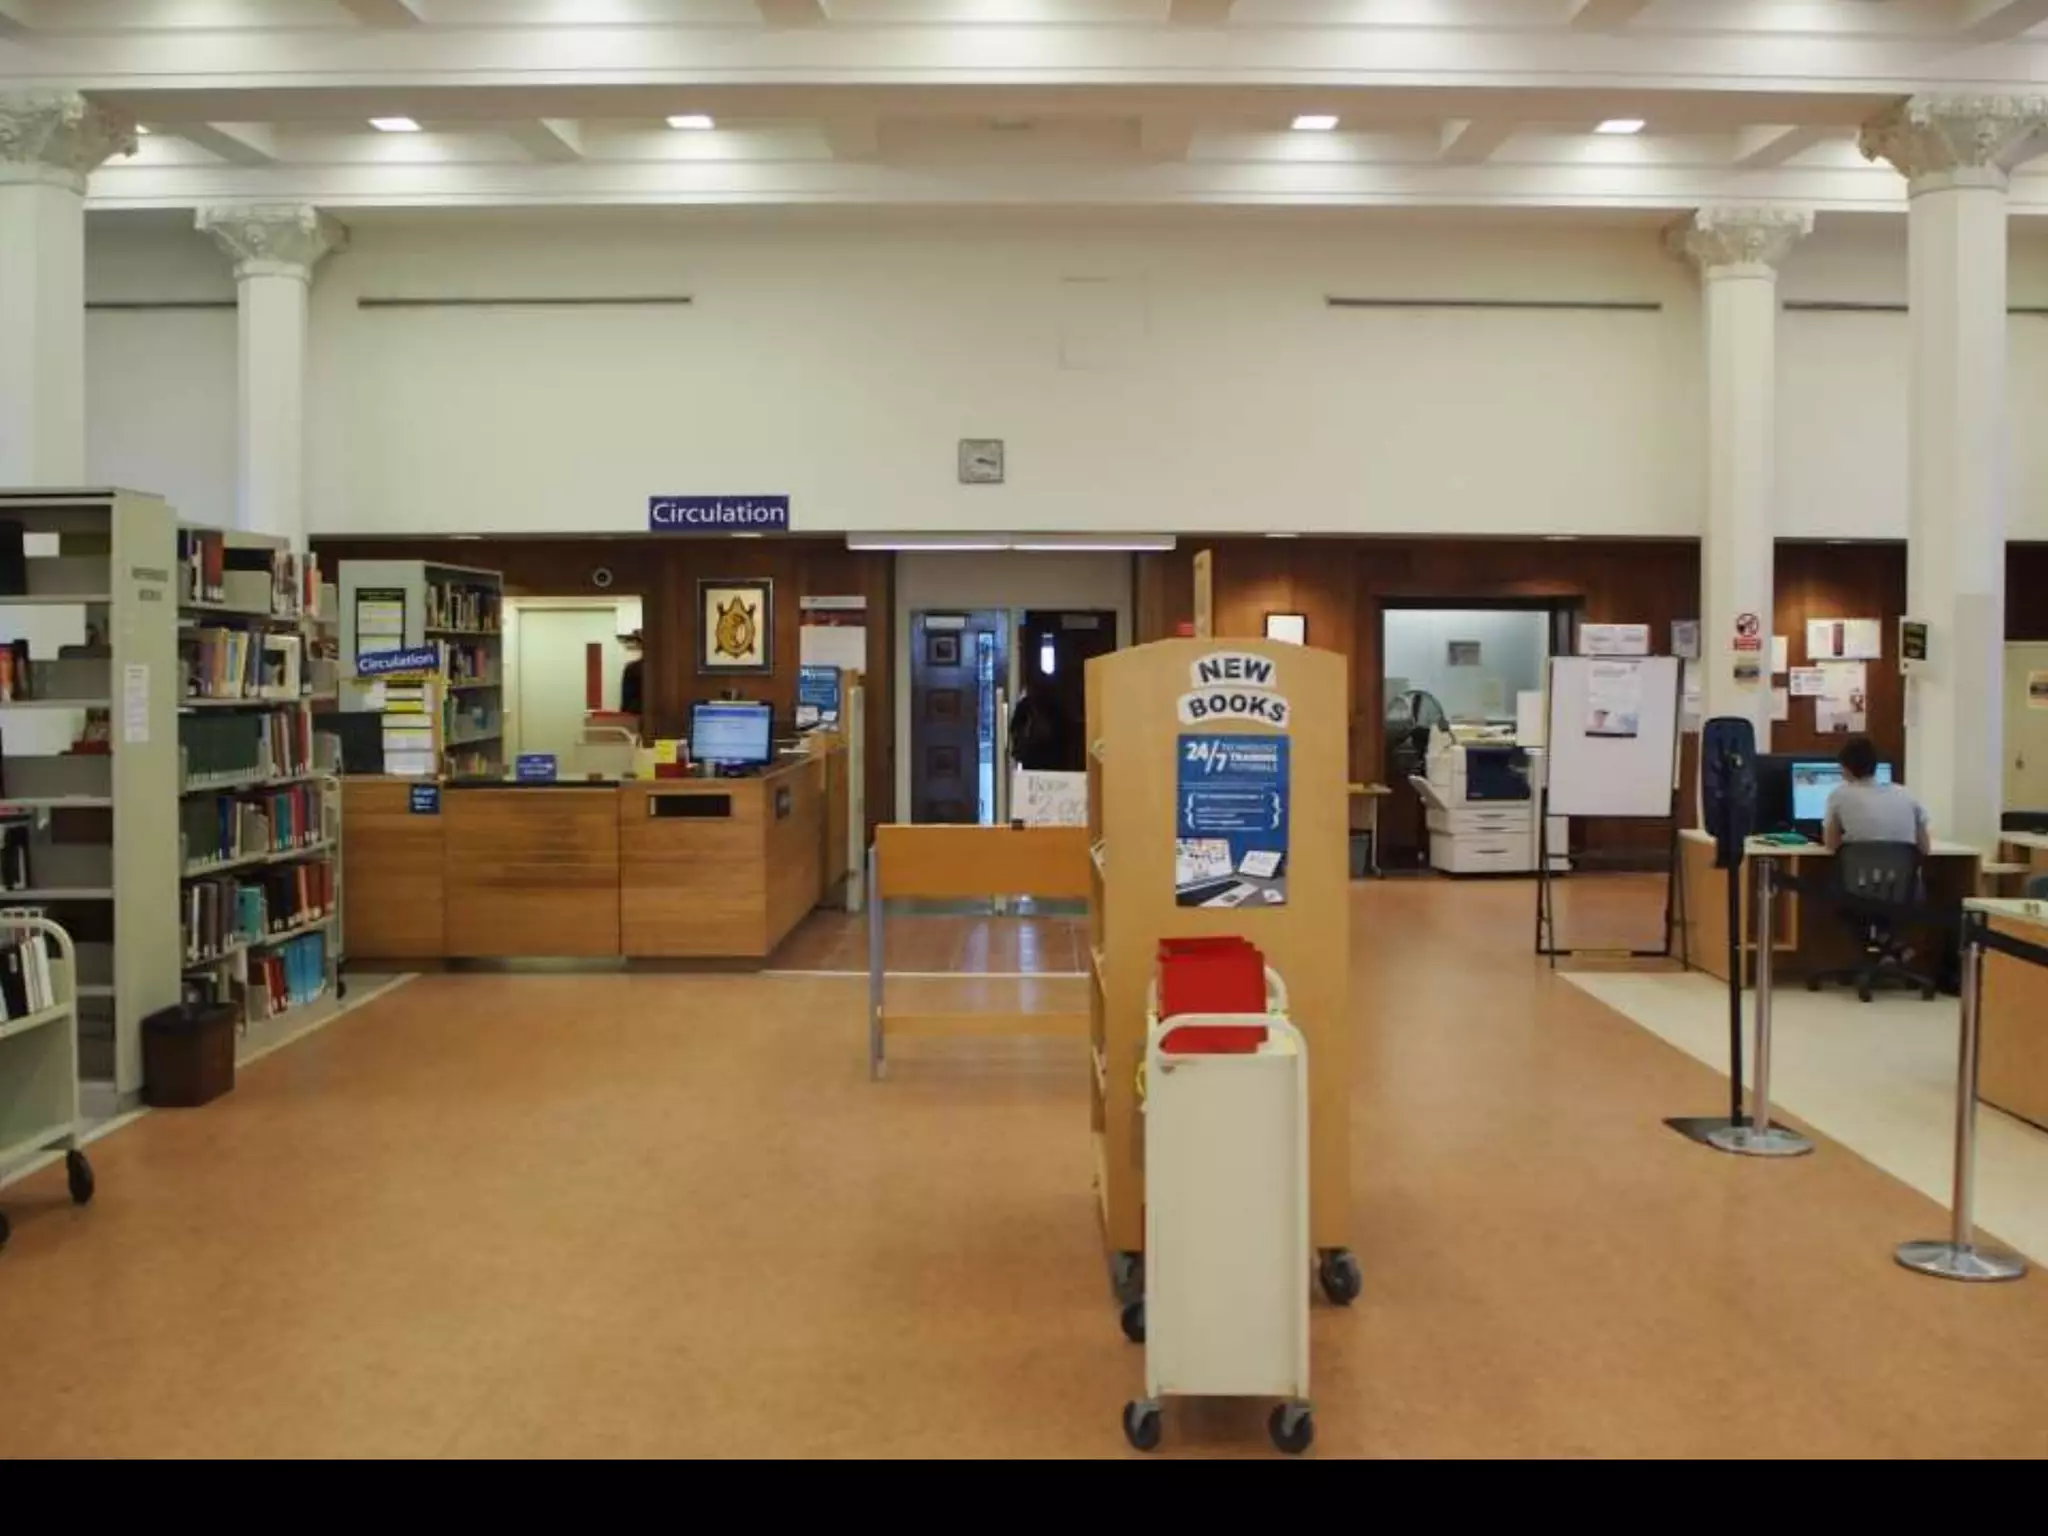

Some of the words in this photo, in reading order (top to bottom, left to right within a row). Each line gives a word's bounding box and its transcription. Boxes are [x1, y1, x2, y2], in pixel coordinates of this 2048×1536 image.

[652, 501, 785, 523] Circulation
[359, 653, 434, 672] Circulation
[1198, 657, 1272, 683] NEW
[1188, 693, 1286, 722] BOOKS
[1185, 740, 1227, 774] 24/7
